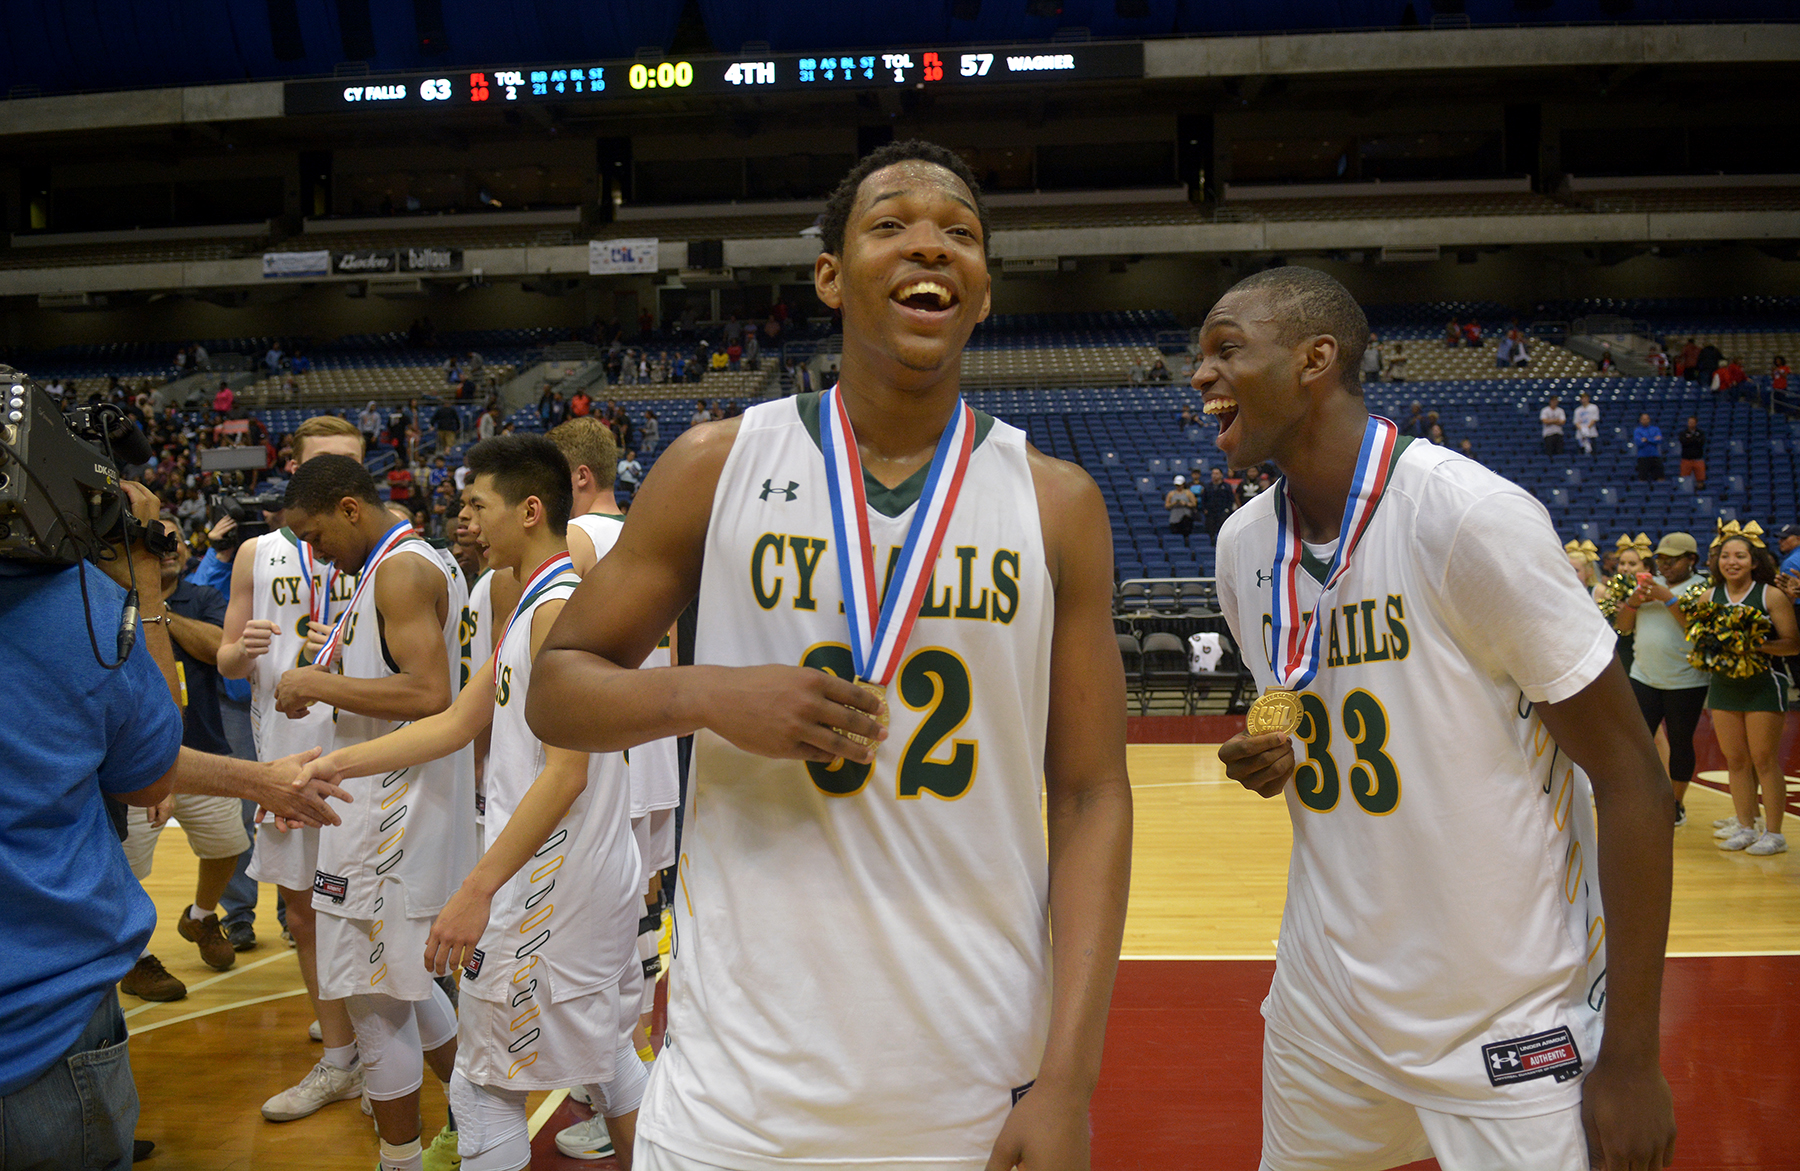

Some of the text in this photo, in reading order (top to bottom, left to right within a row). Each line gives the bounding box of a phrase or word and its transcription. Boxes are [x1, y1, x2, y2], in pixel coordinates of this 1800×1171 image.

[799, 58, 817, 69] RB
[820, 58, 837, 69] AS
[860, 56, 876, 67] ST
[882, 54, 914, 69] TOL
[923, 52, 943, 67] FL
[960, 54, 994, 76] 57
[1007, 54, 1075, 71] WAGNER
[470, 73, 489, 87] FL
[494, 71, 525, 86] TOL
[531, 71, 548, 82] RB
[550, 70, 567, 82] AS
[588, 68, 604, 80] ST
[629, 62, 693, 89] 0:00
[724, 62, 775, 85] 4TH
[799, 68, 874, 82] 31 4 1 4
[894, 68, 905, 82] 1
[344, 85, 406, 102] CY FALLS
[420, 79, 452, 101] 63
[506, 86, 517, 100] 2
[532, 80, 605, 95] 21 4 1 10
[94, 463, 108, 475] LDK
[751, 532, 1021, 626] CY LLS
[272, 577, 301, 606] CY
[1293, 687, 1402, 817] 33
[1520, 1036, 1567, 1052] UNDER ARMOUR
[1530, 1049, 1567, 1066] AUTHENTIC
